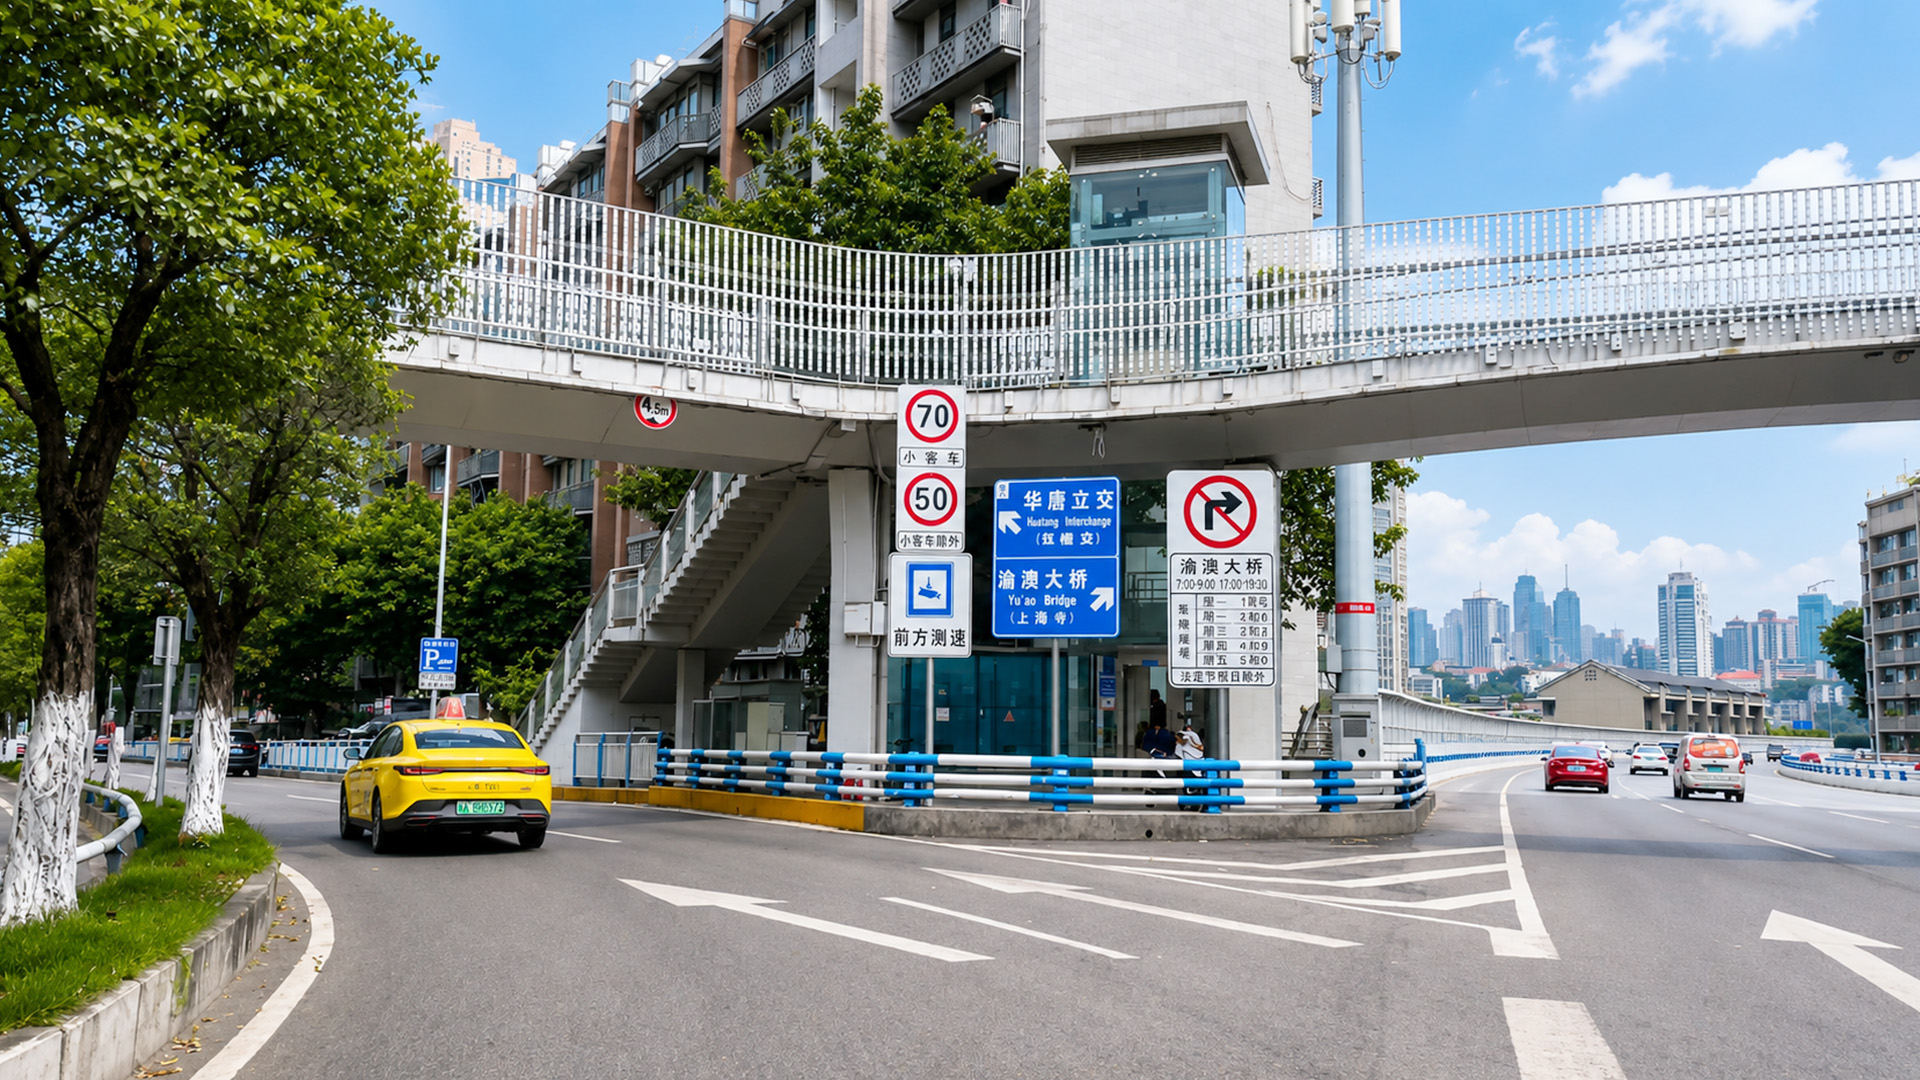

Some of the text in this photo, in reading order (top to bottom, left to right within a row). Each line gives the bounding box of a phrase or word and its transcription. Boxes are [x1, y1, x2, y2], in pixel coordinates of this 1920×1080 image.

[642, 396, 669, 416] 4.5m
[917, 404, 949, 428] 70
[904, 450, 960, 465] 小客车
[915, 487, 947, 511] 50
[1024, 489, 1114, 511] 华唐立交
[1065, 516, 1112, 529] Interchange
[1180, 557, 1263, 575] 渝澳大桥
[998, 568, 1088, 590] 渝澳大桥
[1008, 594, 1077, 608] Yu'ao Bridge
[894, 627, 966, 647] 前方测速
[423, 649, 440, 670] P
